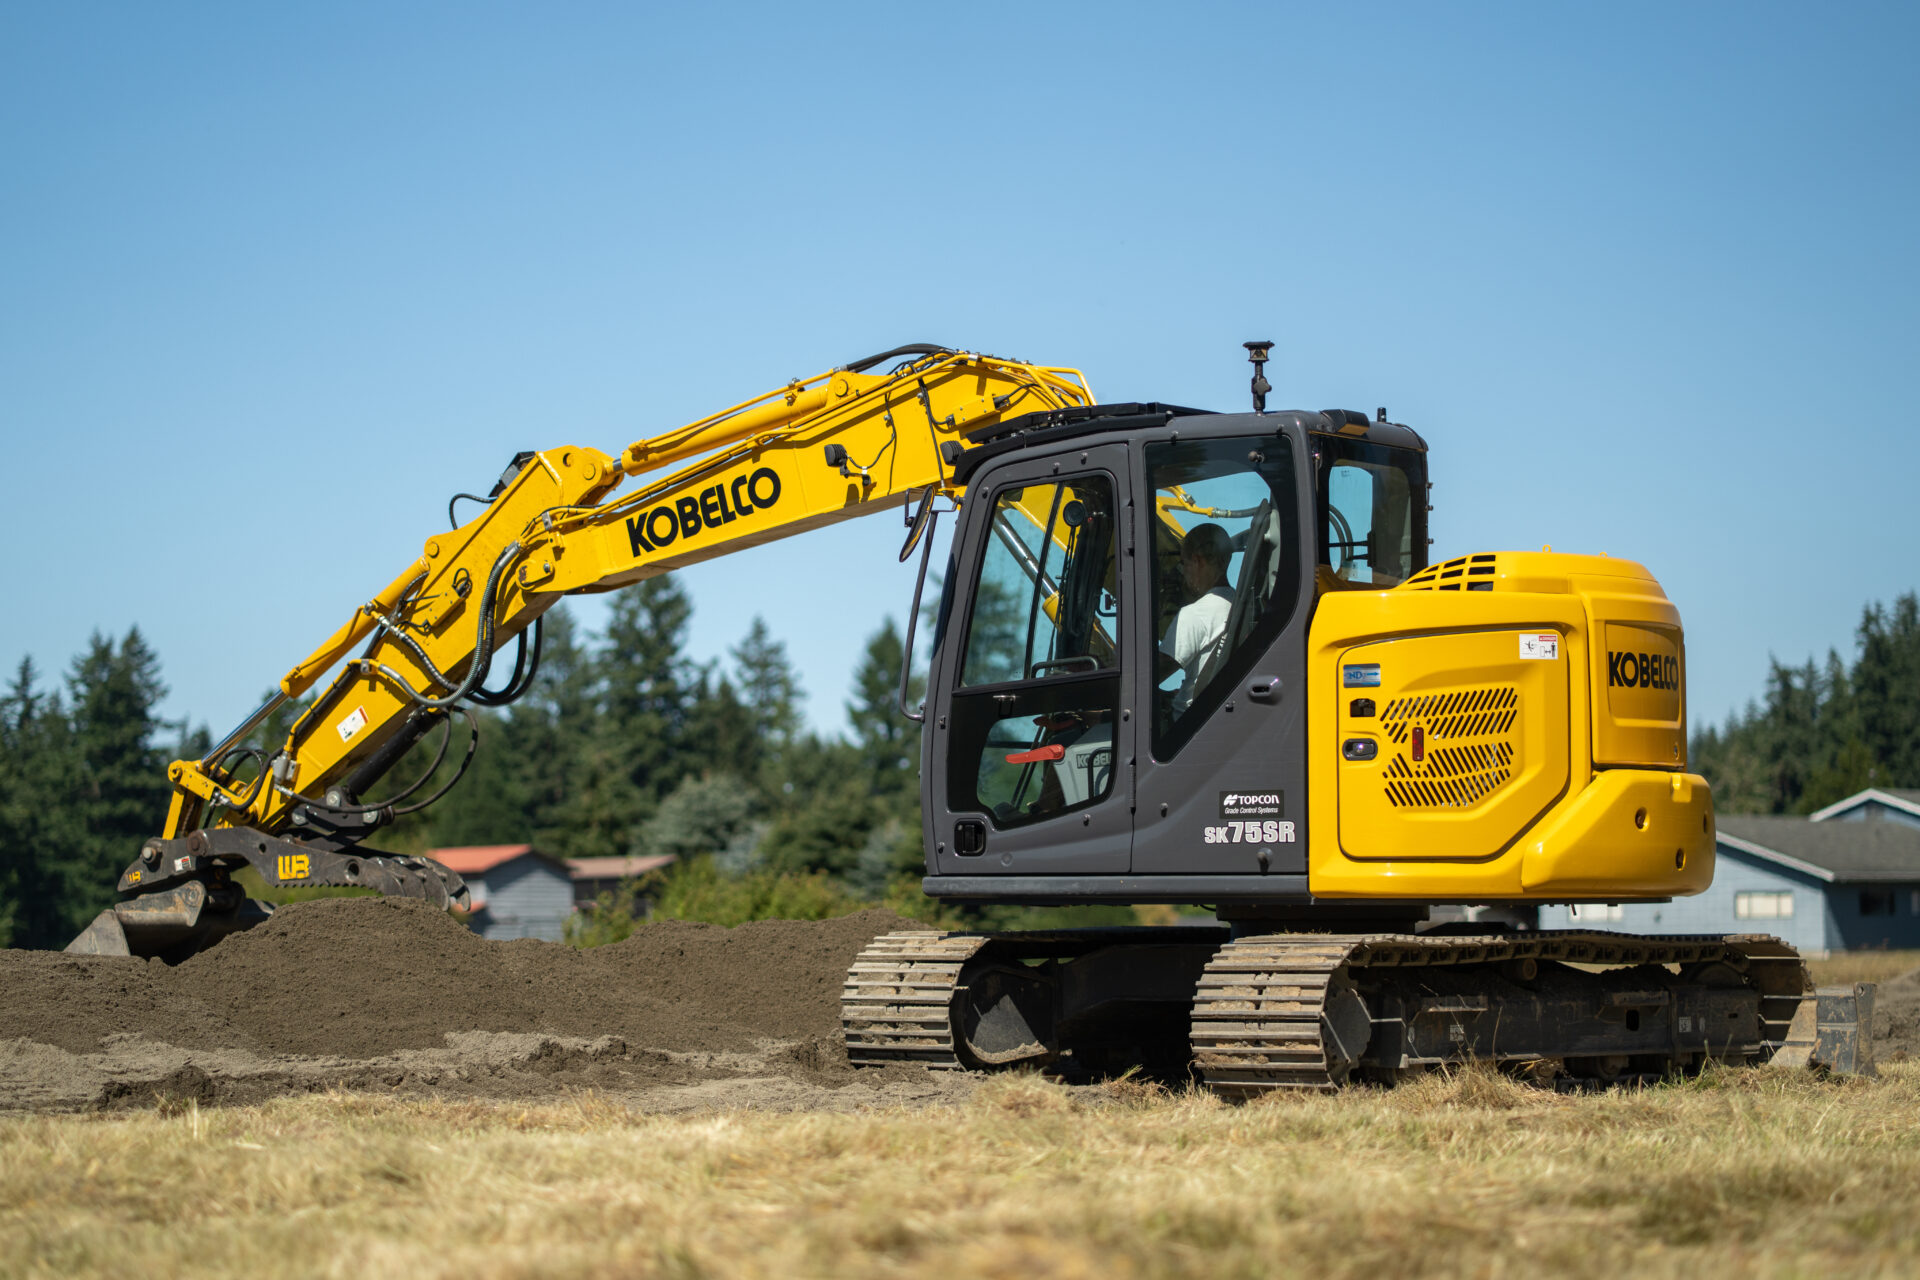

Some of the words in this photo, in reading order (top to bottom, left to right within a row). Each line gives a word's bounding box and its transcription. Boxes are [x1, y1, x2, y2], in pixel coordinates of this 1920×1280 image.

[626, 467, 781, 558] KOBELCO
[1608, 651, 1679, 691] KOBELCO
[1238, 794, 1280, 805] TOPCON
[1258, 806, 1279, 815] Systems
[1204, 820, 1296, 844] SK75SR
